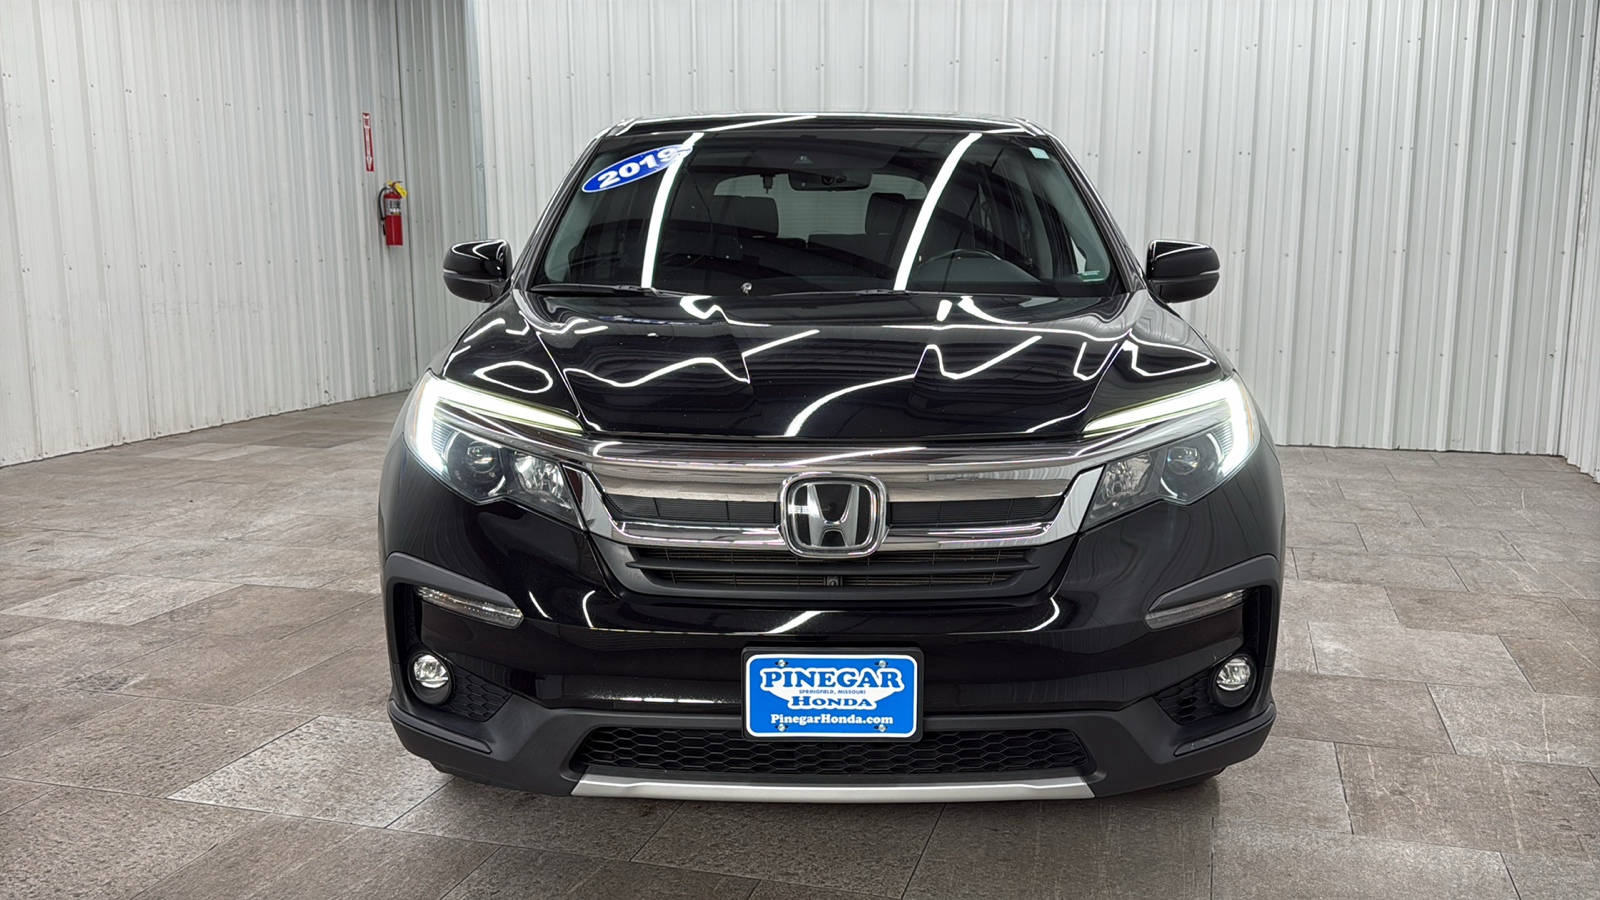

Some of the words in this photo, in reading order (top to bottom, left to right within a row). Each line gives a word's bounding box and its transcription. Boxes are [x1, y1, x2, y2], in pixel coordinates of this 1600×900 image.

[597, 147, 678, 189] 2019
[763, 671, 901, 688] PINEGAR
[791, 695, 875, 707] HONDA
[770, 713, 894, 726] PinegarHonda.com
